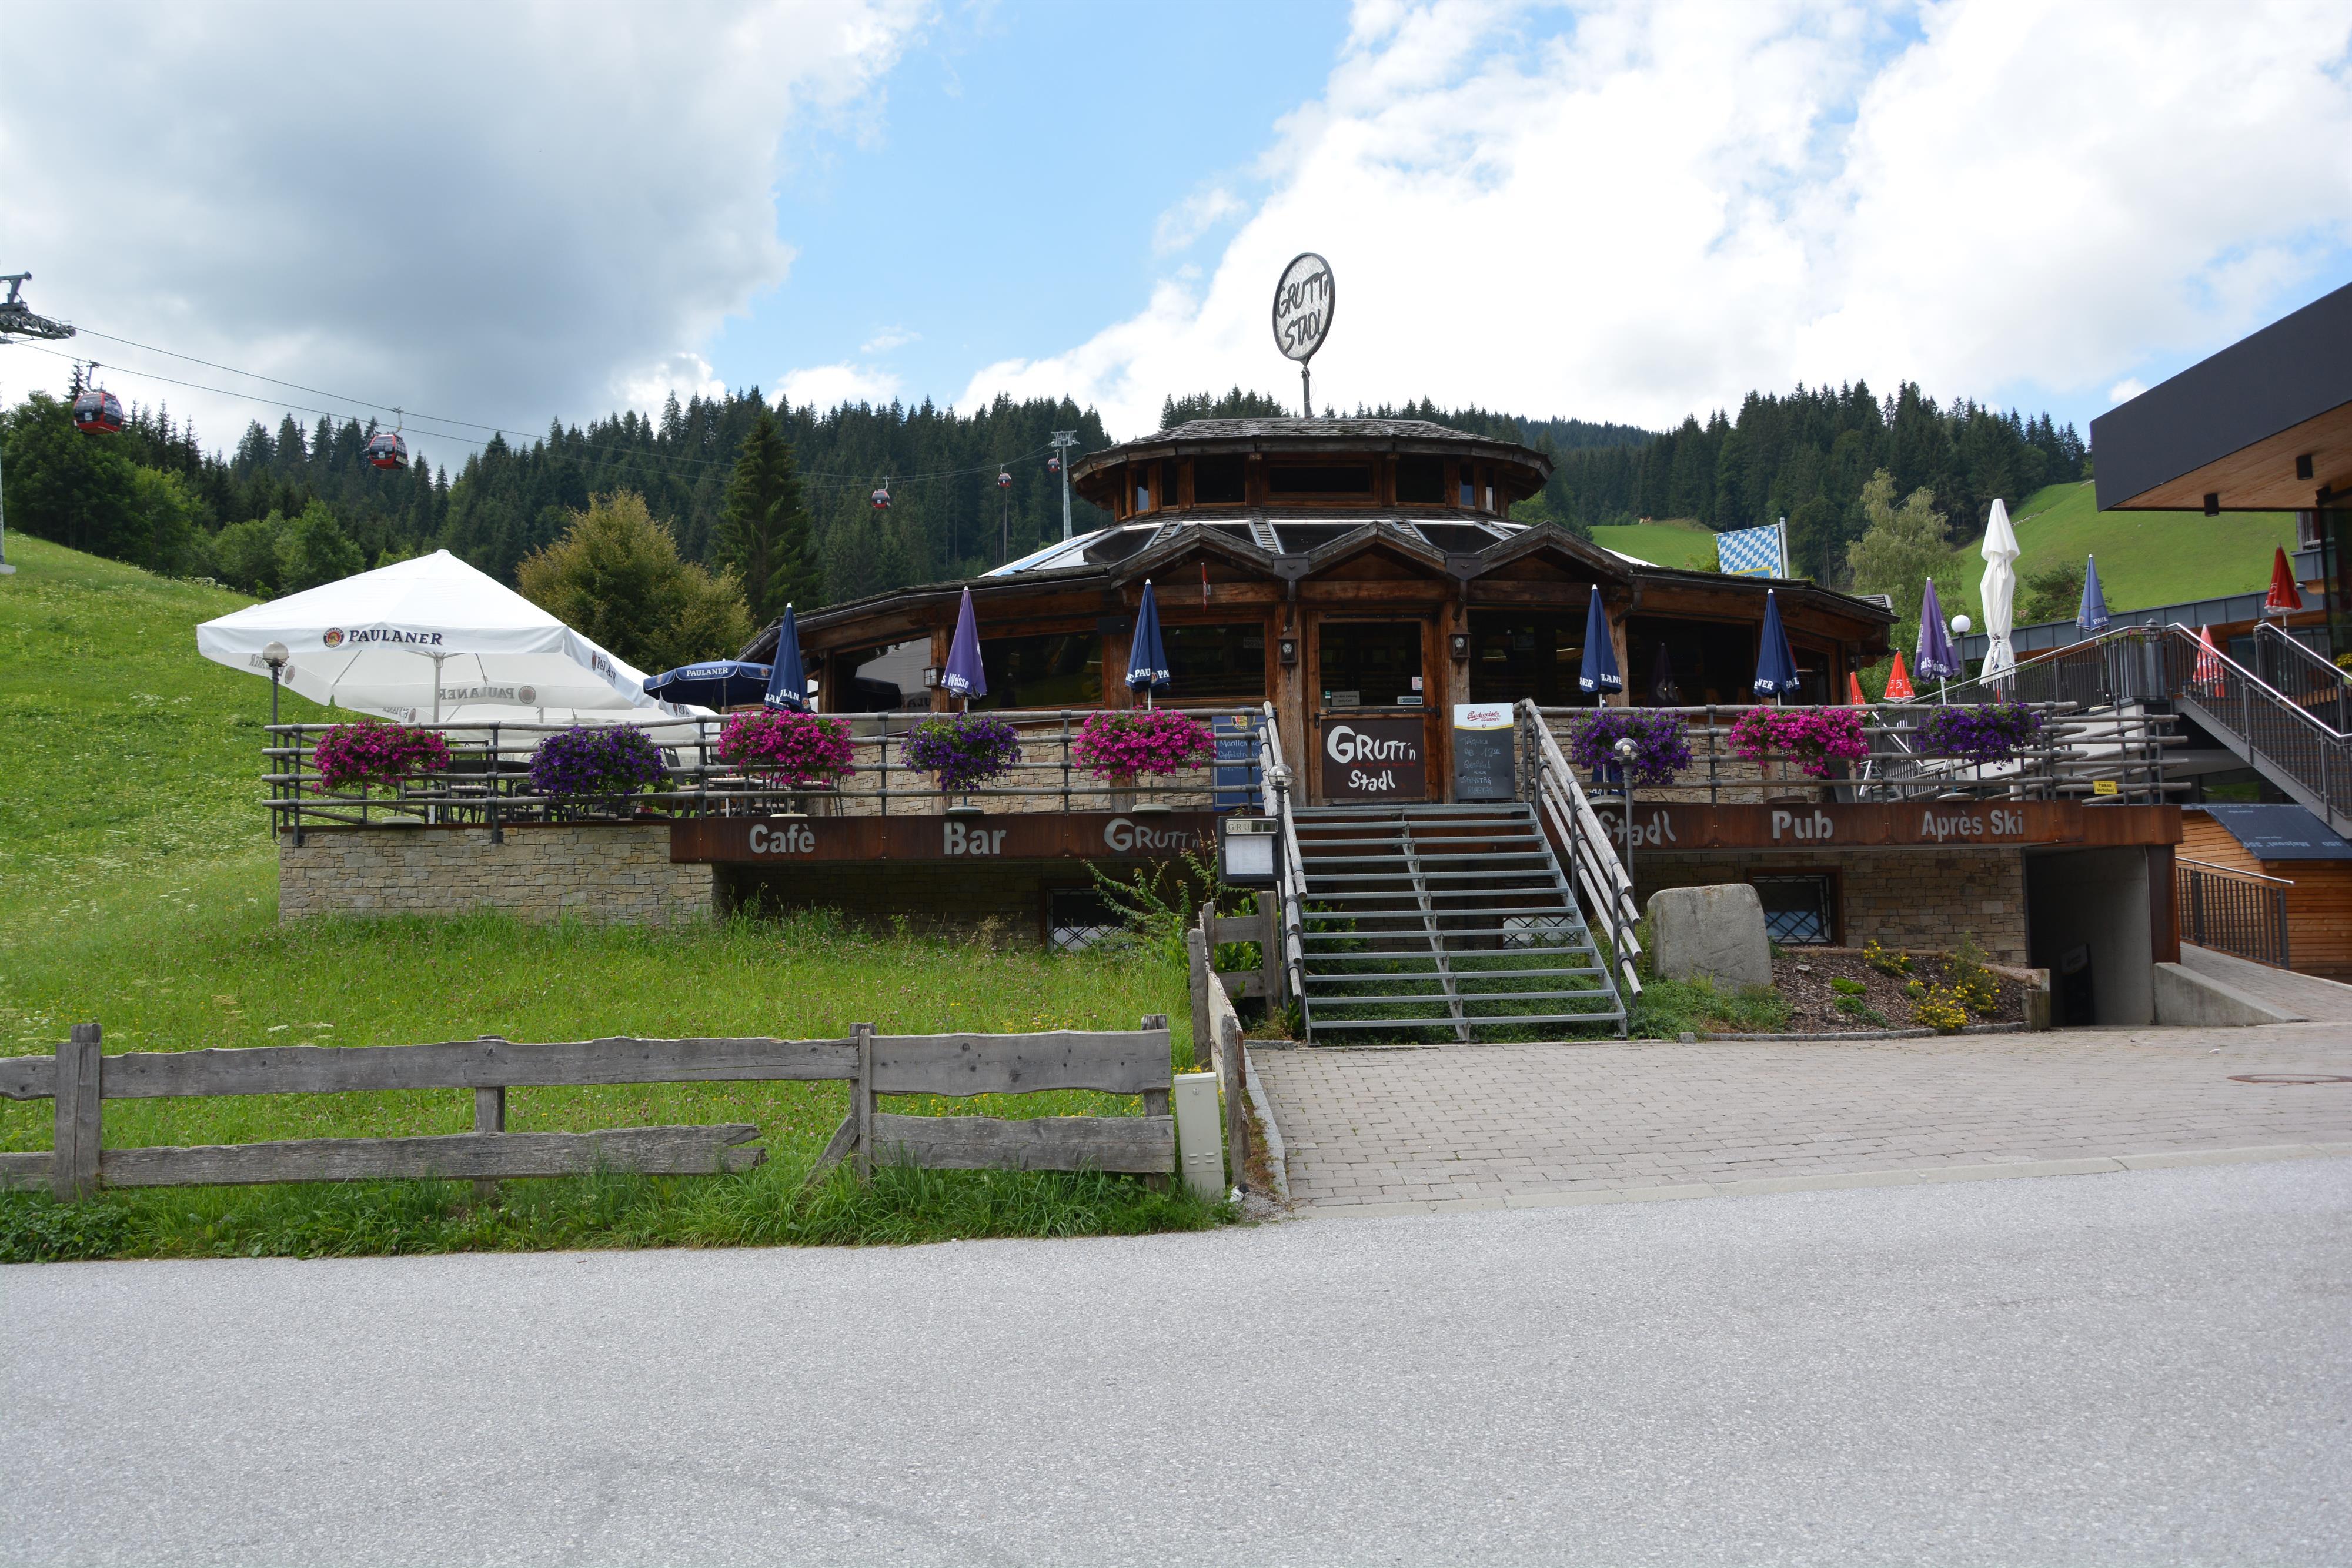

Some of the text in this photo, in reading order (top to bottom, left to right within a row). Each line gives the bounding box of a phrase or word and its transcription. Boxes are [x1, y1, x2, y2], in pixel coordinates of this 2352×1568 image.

[348, 629, 443, 646] PAULANER
[686, 667, 729, 677] PAULANER
[948, 673, 970, 689] Weisse
[1157, 669, 1170, 679] PA
[1467, 711, 1501, 721] Budweiser
[1348, 770, 1396, 791] Stadl
[1598, 810, 1676, 846] Stadl
[1772, 810, 1833, 839] Pub
[1921, 809, 2023, 842] Après Ski
[749, 823, 816, 854] Cafè
[944, 822, 1007, 855] Bar
